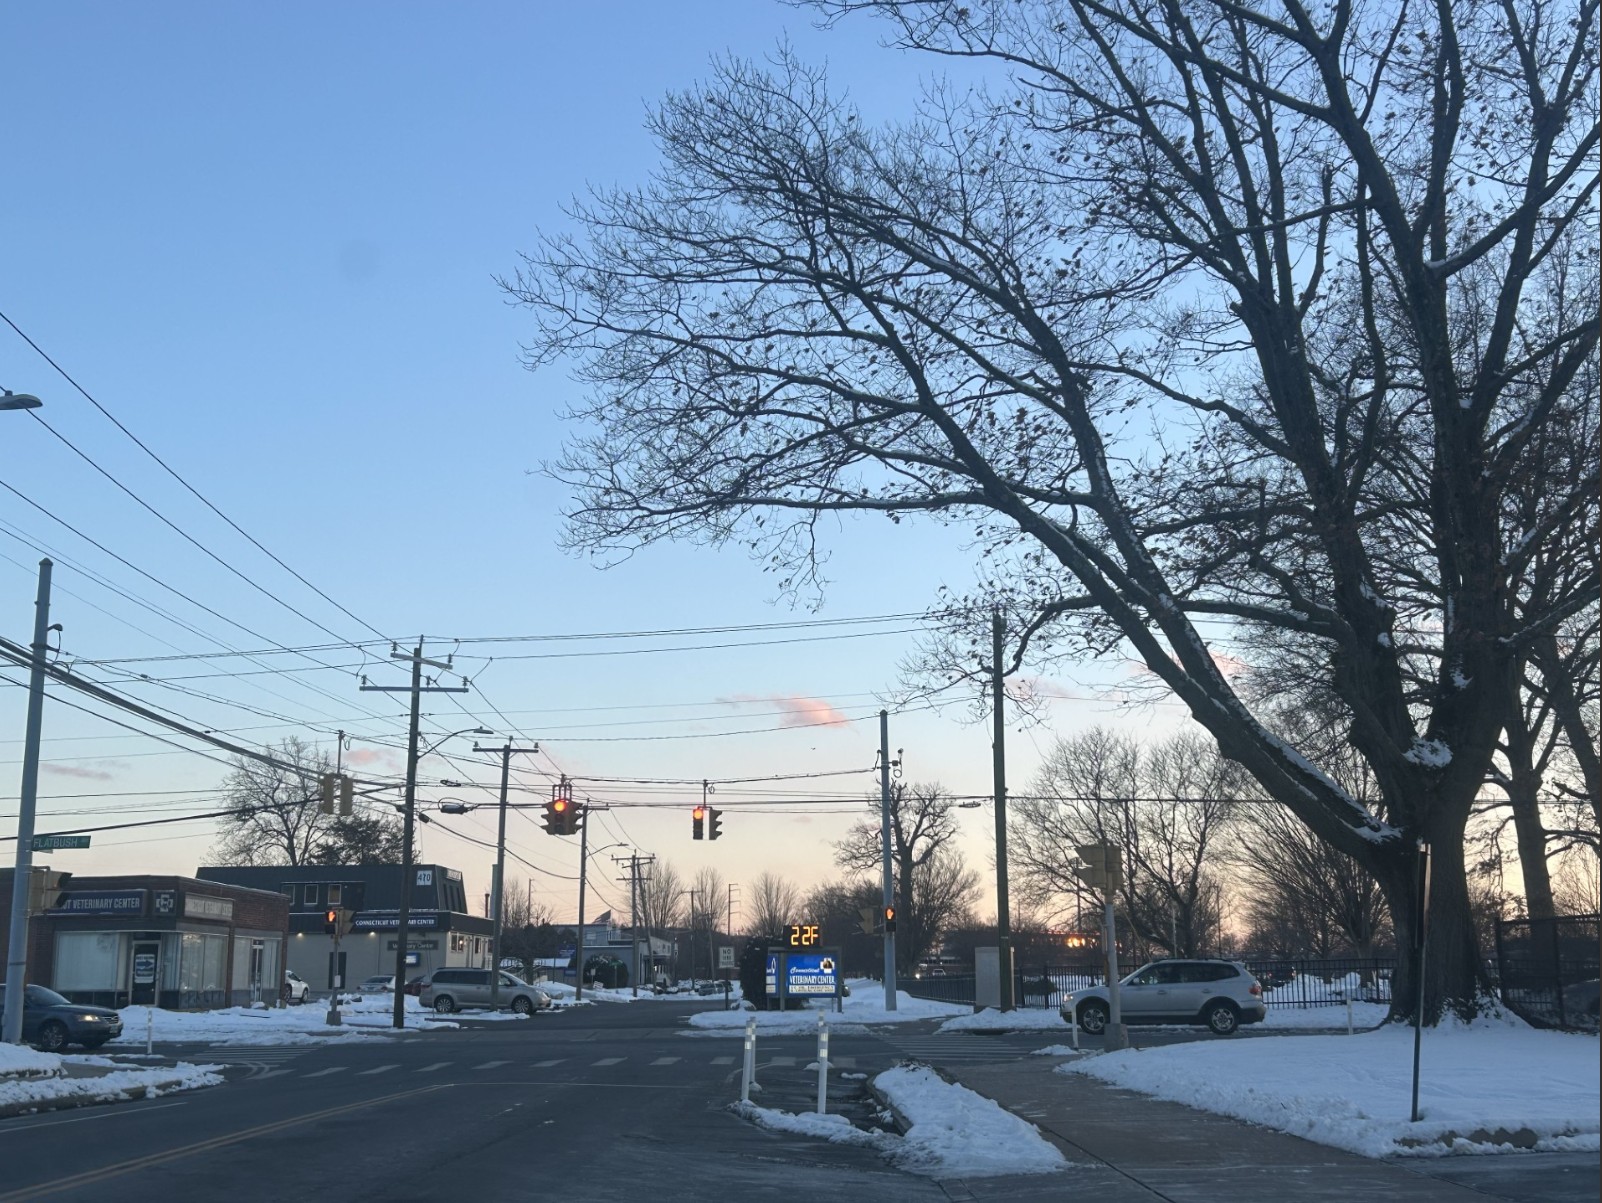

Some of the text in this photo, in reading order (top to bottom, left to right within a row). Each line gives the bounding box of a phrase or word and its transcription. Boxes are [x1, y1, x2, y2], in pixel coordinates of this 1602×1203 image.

[34, 838, 78, 848] FLATBUSH
[73, 899, 113, 909] VETERINARY
[114, 898, 140, 908] CENTER
[789, 975, 835, 984] VETERINARY CENTER
